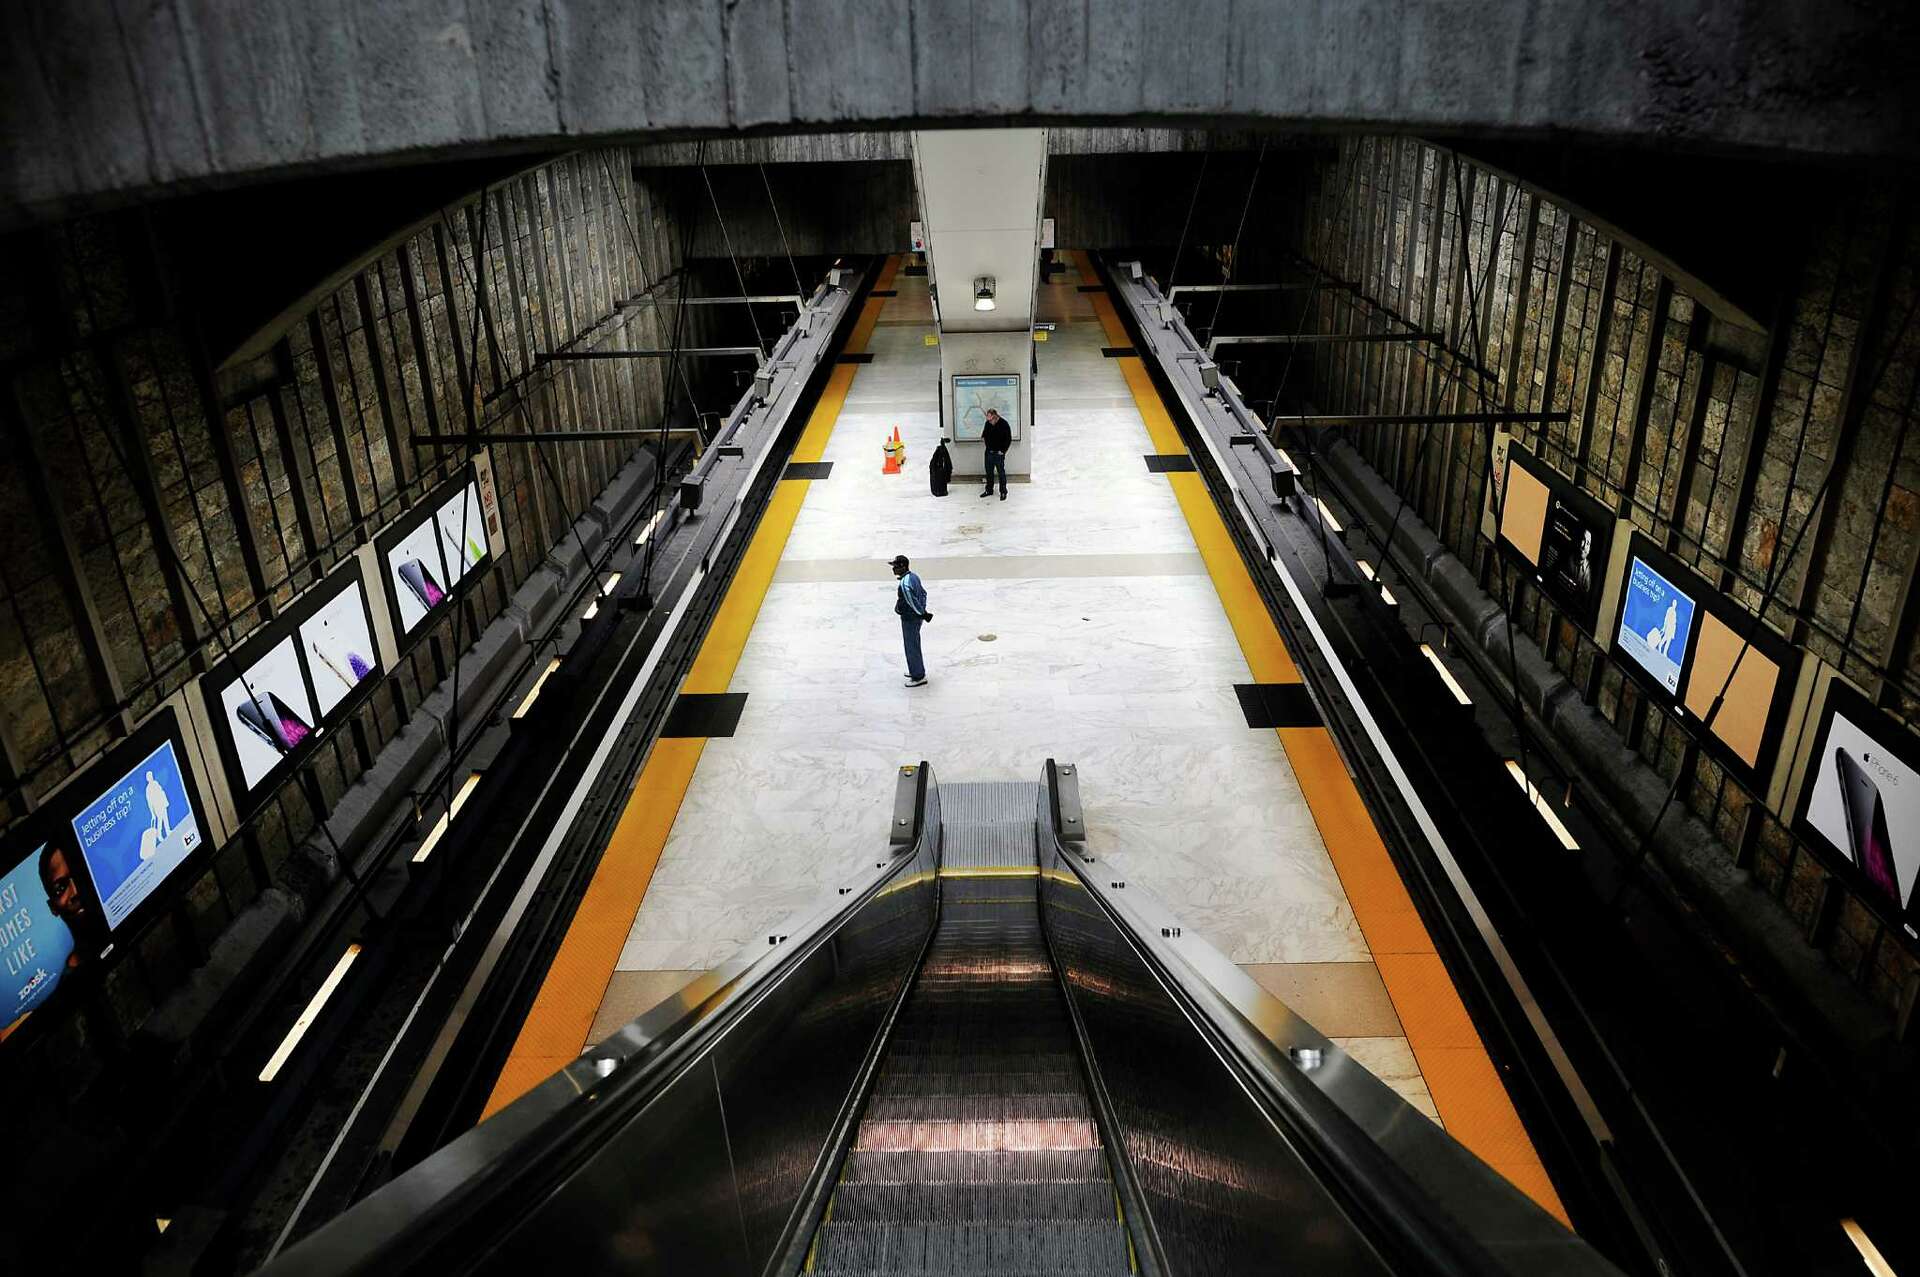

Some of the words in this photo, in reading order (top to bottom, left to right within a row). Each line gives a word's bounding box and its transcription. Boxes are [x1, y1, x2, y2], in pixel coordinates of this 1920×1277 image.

[81, 810, 107, 836] Jetting
[106, 797, 117, 814] off
[118, 791, 128, 804] on
[128, 786, 134, 796] a
[84, 817, 116, 848] business
[115, 800, 131, 820] trip?
[0, 907, 32, 950] OMES
[6, 938, 37, 976] LIKE
[18, 967, 47, 1001] zoosk
